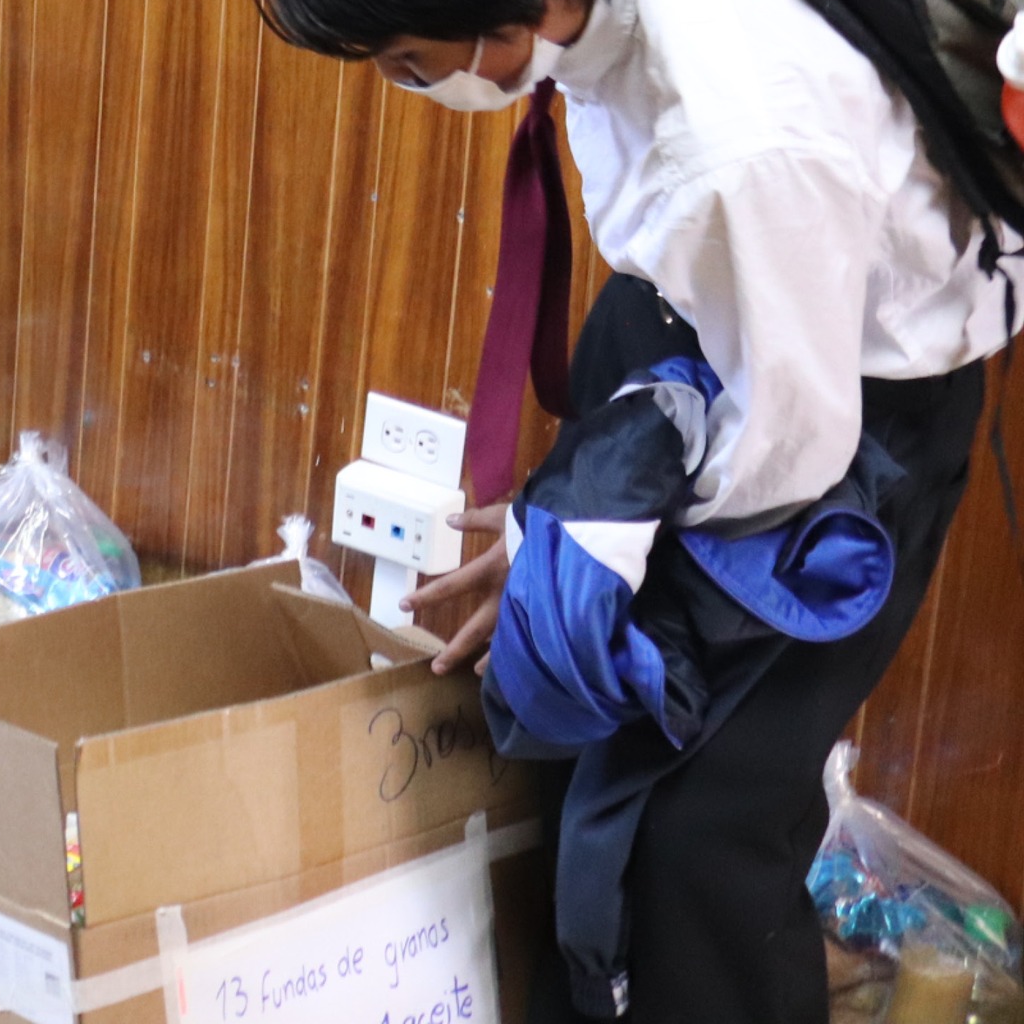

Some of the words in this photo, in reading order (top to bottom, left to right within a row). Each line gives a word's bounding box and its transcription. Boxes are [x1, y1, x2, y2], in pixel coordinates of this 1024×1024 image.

[216, 976, 249, 1021] 13
[261, 961, 328, 1013] fundas
[337, 946, 364, 977] de
[385, 917, 450, 989] granos
